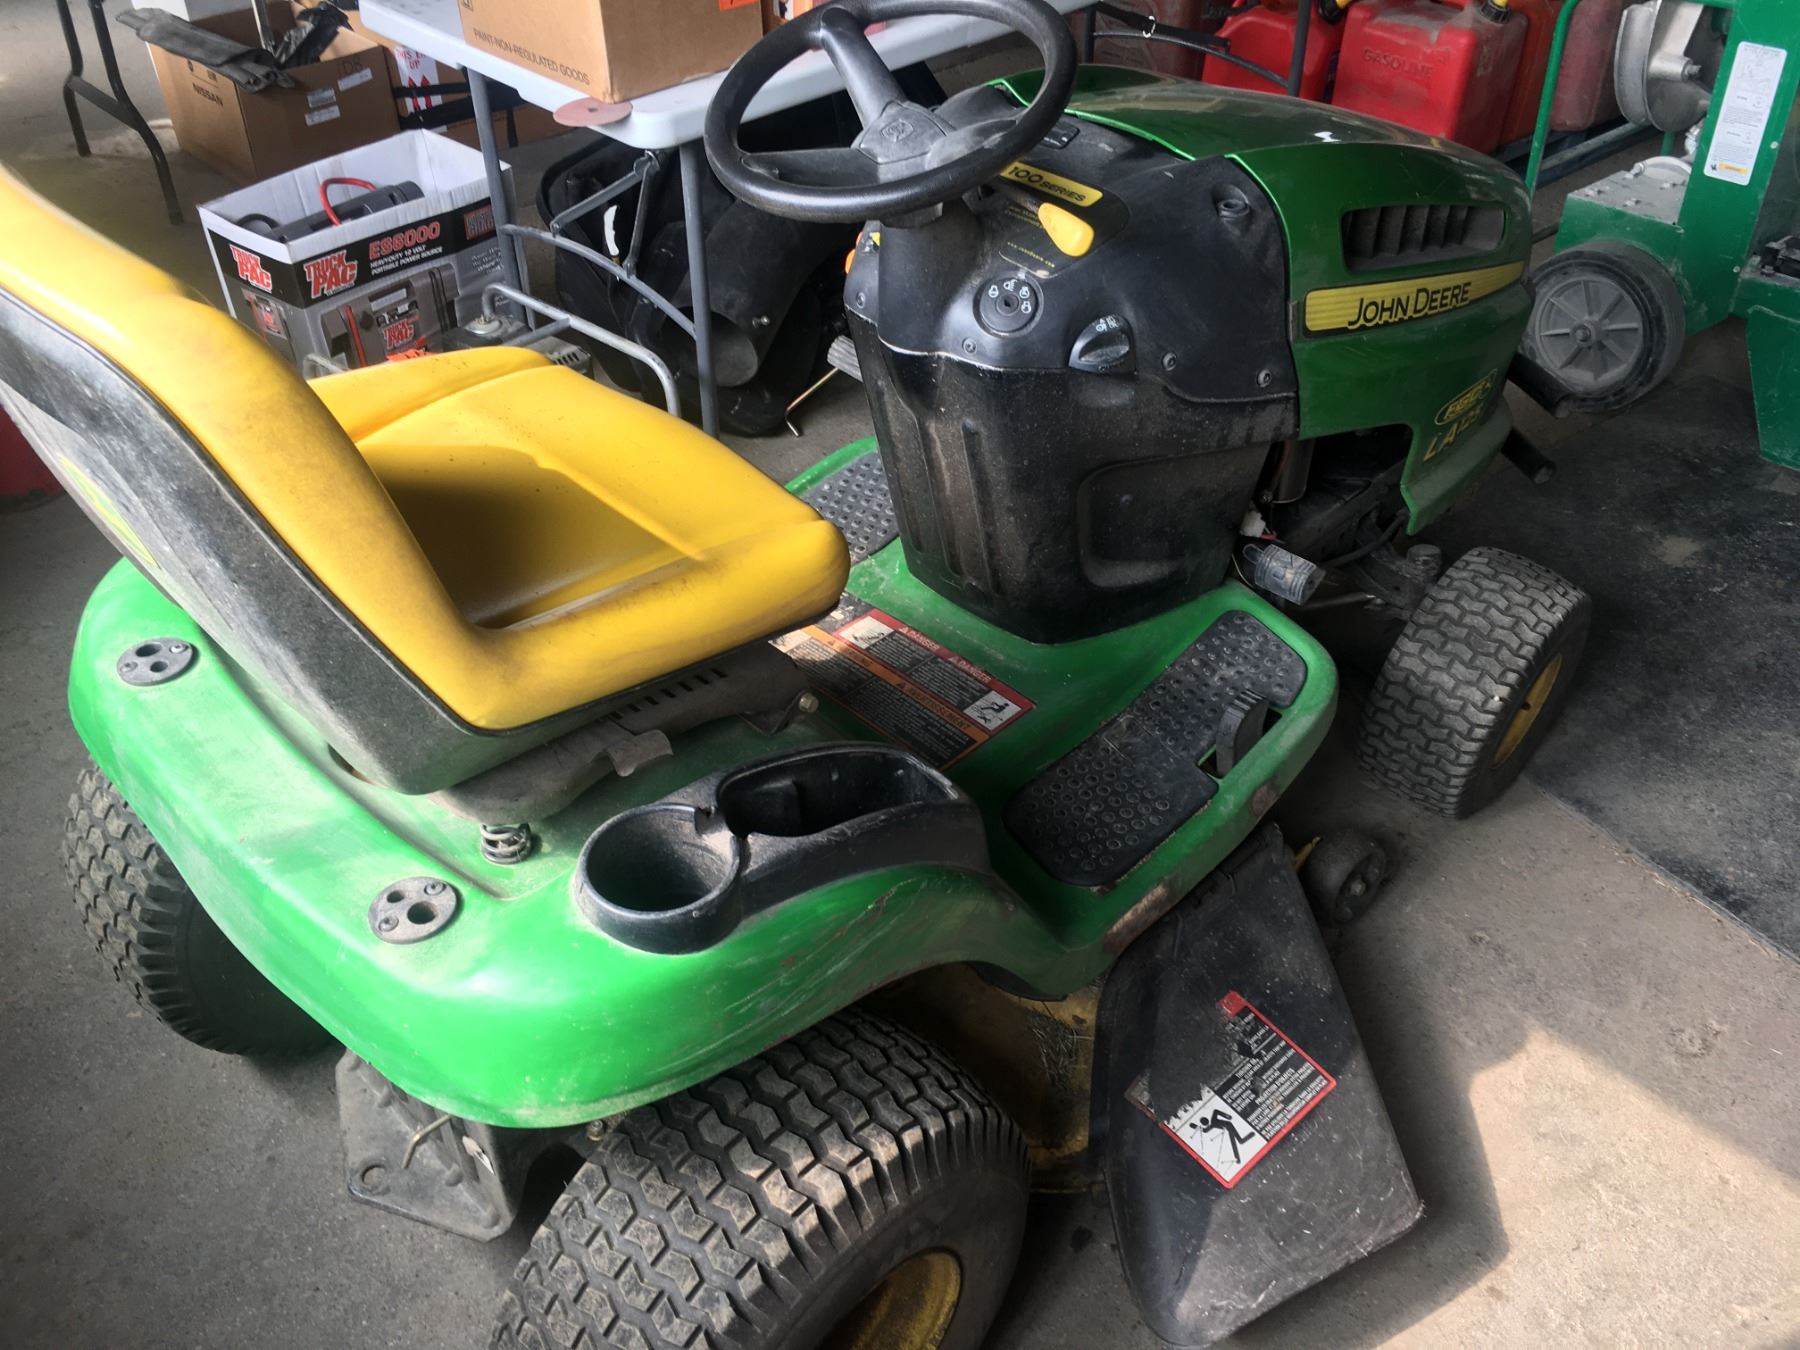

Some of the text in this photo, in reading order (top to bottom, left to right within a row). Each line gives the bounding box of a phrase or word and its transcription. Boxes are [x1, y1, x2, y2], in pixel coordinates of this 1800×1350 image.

[560, 63, 590, 85] GOODS
[1364, 48, 1433, 79] GASOLINE
[1008, 166, 1086, 201] 100 SERIES
[237, 260, 272, 291] PAC
[303, 250, 347, 282] TRUCK
[311, 261, 358, 299] PAC
[1347, 282, 1472, 327] JOHN DEERE
